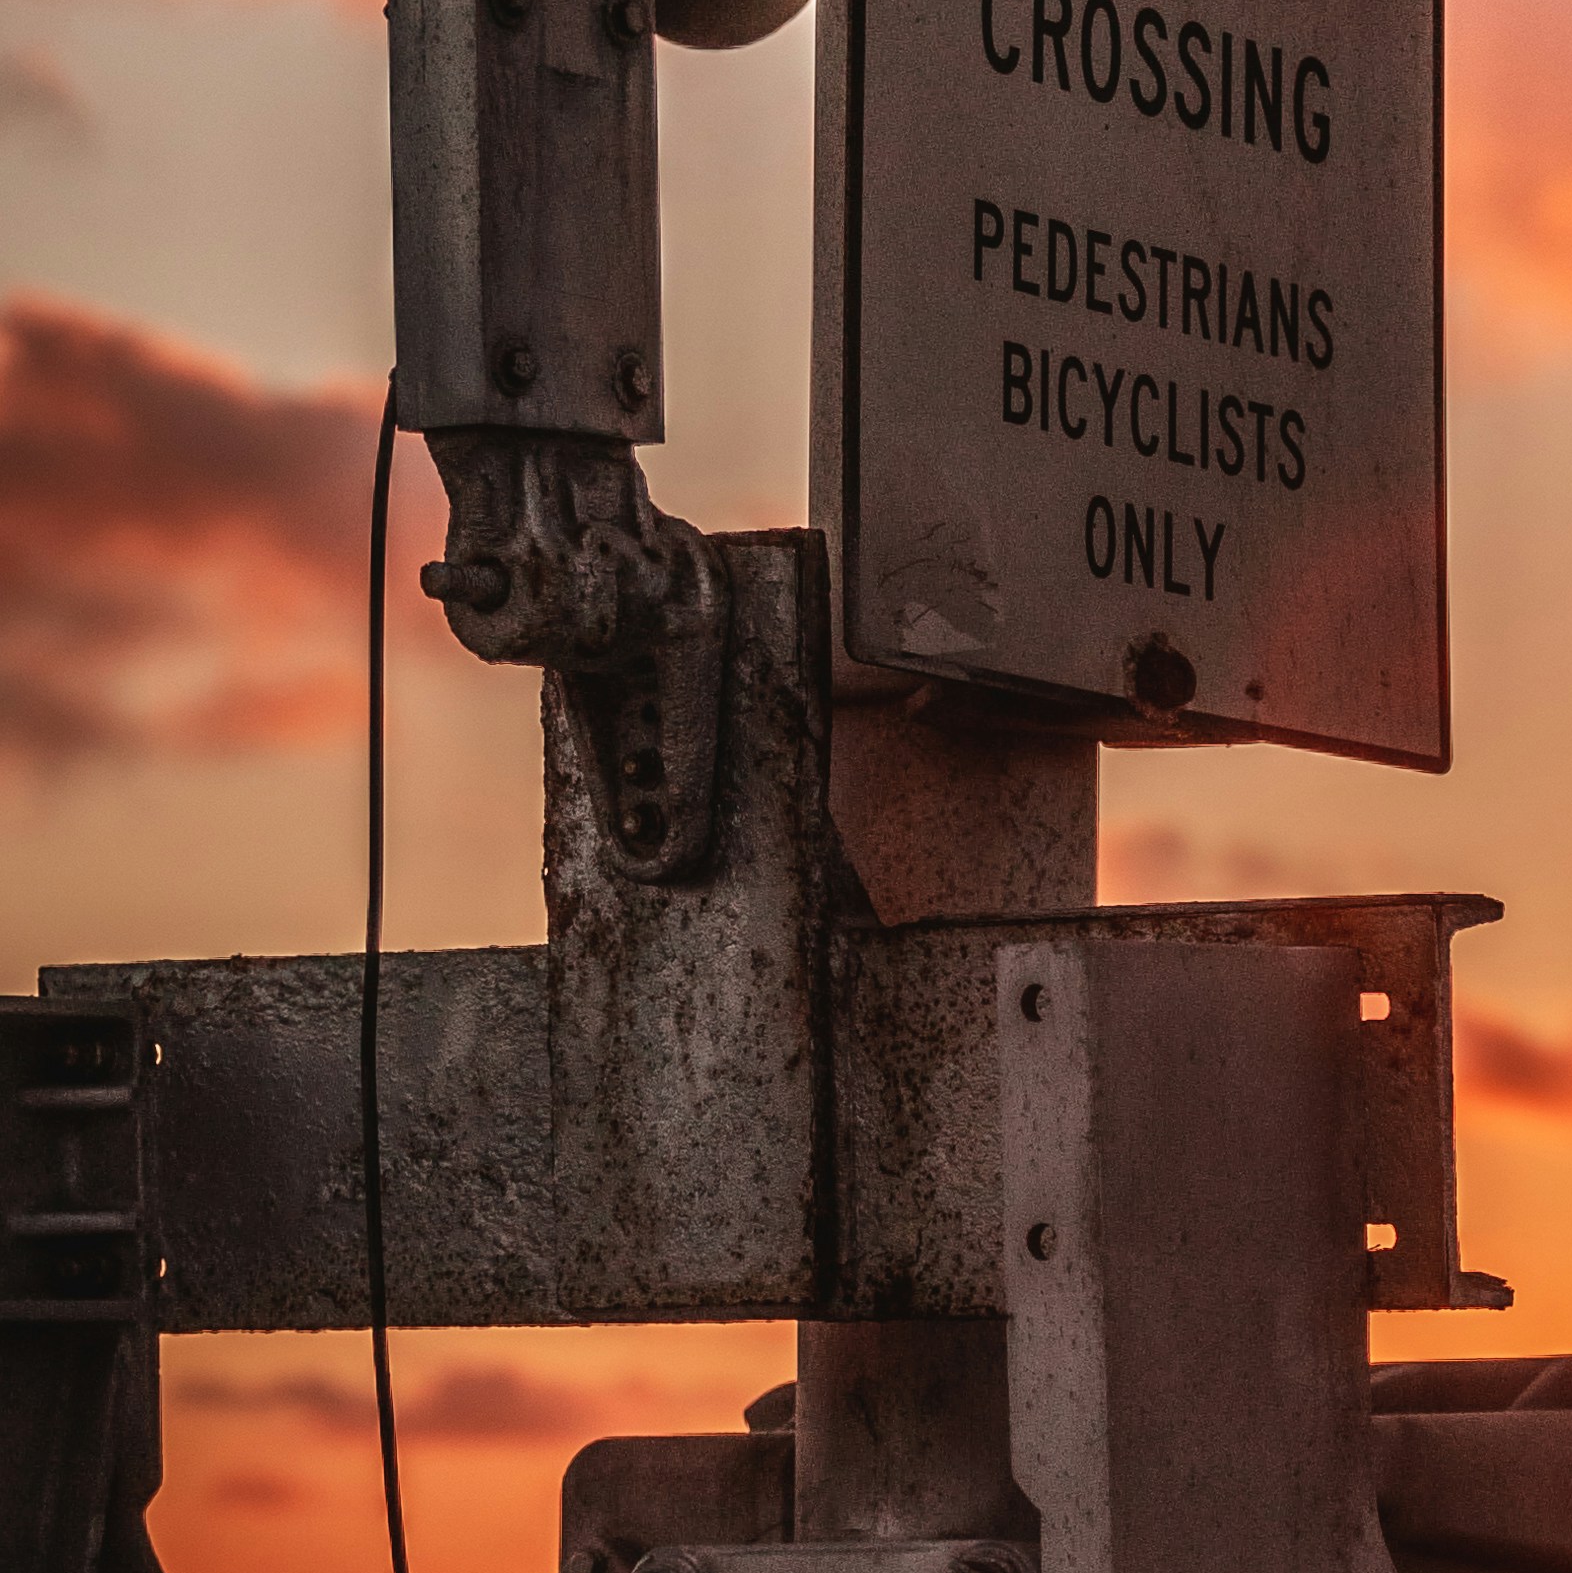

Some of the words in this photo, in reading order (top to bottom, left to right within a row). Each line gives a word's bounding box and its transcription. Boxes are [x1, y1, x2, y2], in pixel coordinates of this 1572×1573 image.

[973, 197, 1335, 371] PEDESTRIANS
[1002, 339, 1307, 491] BICYCLISTS
[1084, 494, 1227, 602] ONLY
